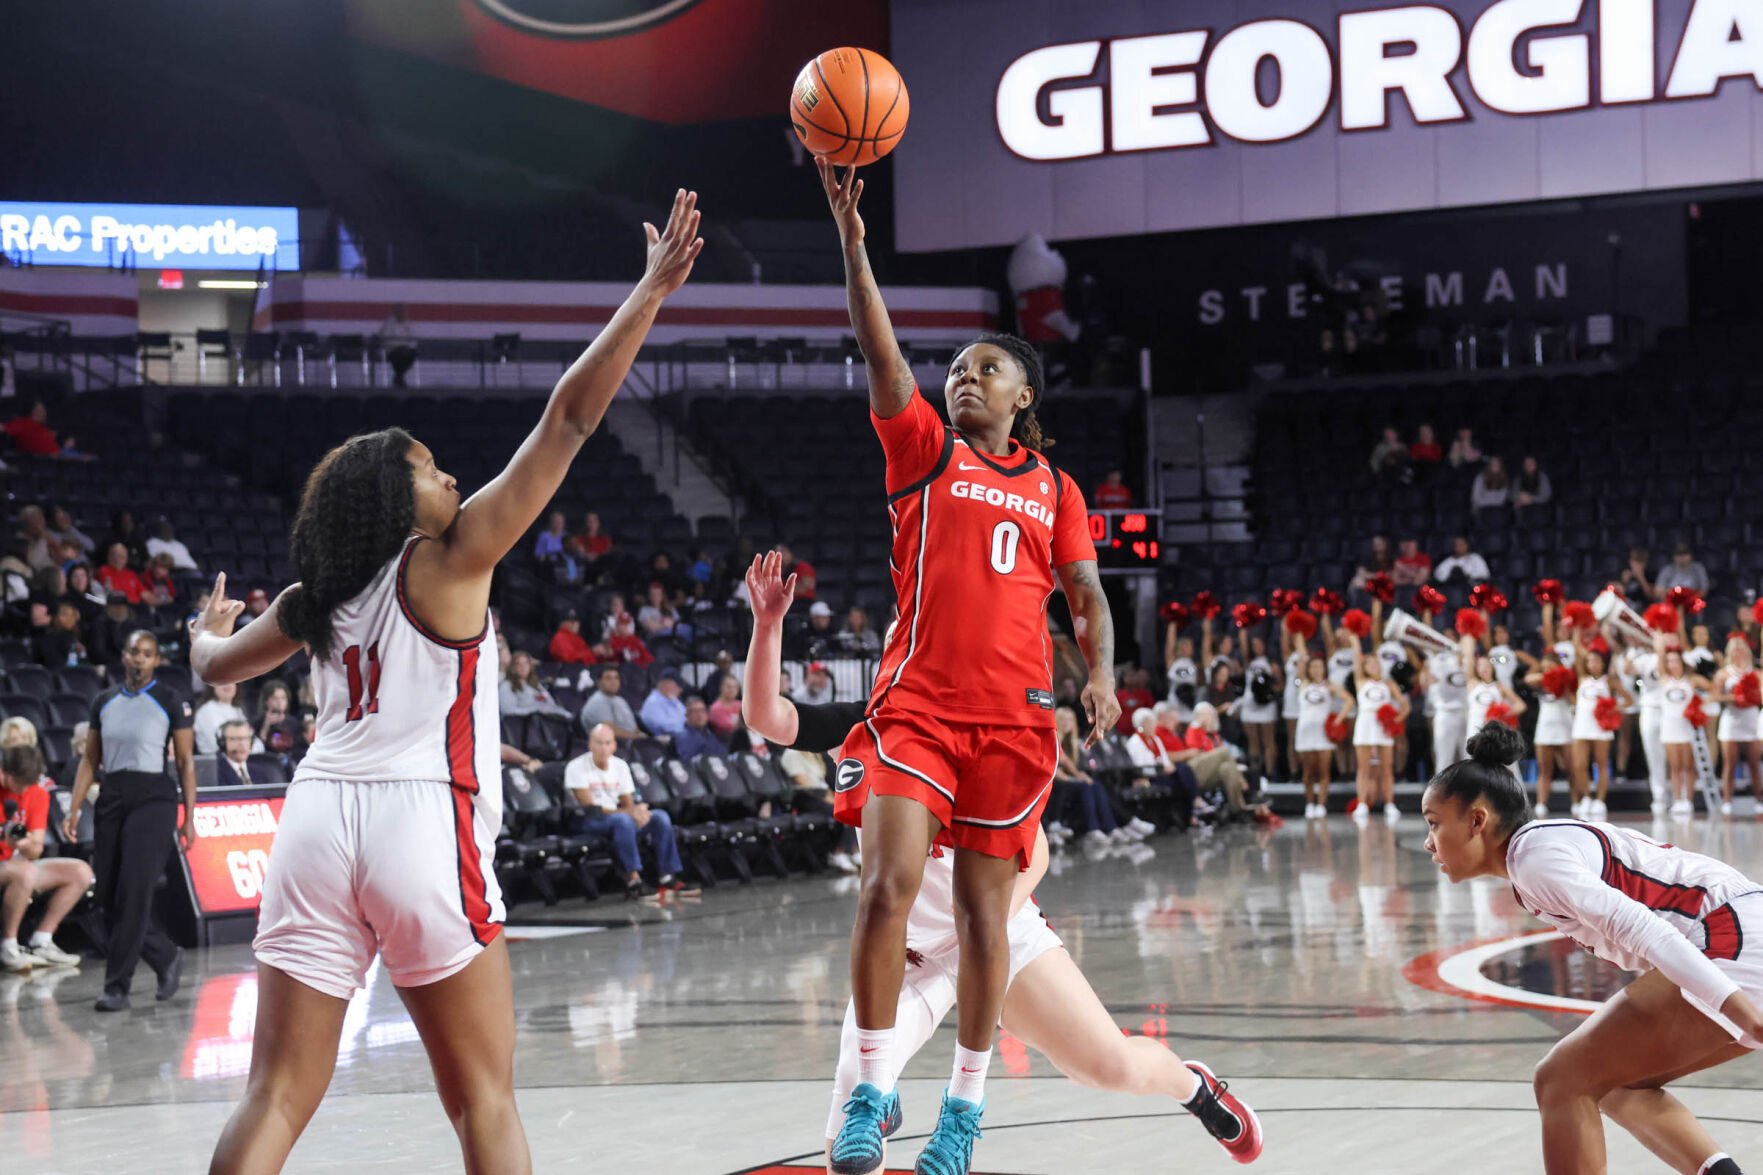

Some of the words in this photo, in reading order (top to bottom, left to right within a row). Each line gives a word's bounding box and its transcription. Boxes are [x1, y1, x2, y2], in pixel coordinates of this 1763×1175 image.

[997, 0, 1763, 161] GEORGIA
[0, 214, 82, 252] RAC
[91, 215, 278, 261] Properties
[1199, 263, 1567, 325] STEEMAN
[950, 480, 1054, 531] GEORGIA
[990, 520, 1020, 575] 0
[342, 640, 381, 724] 11
